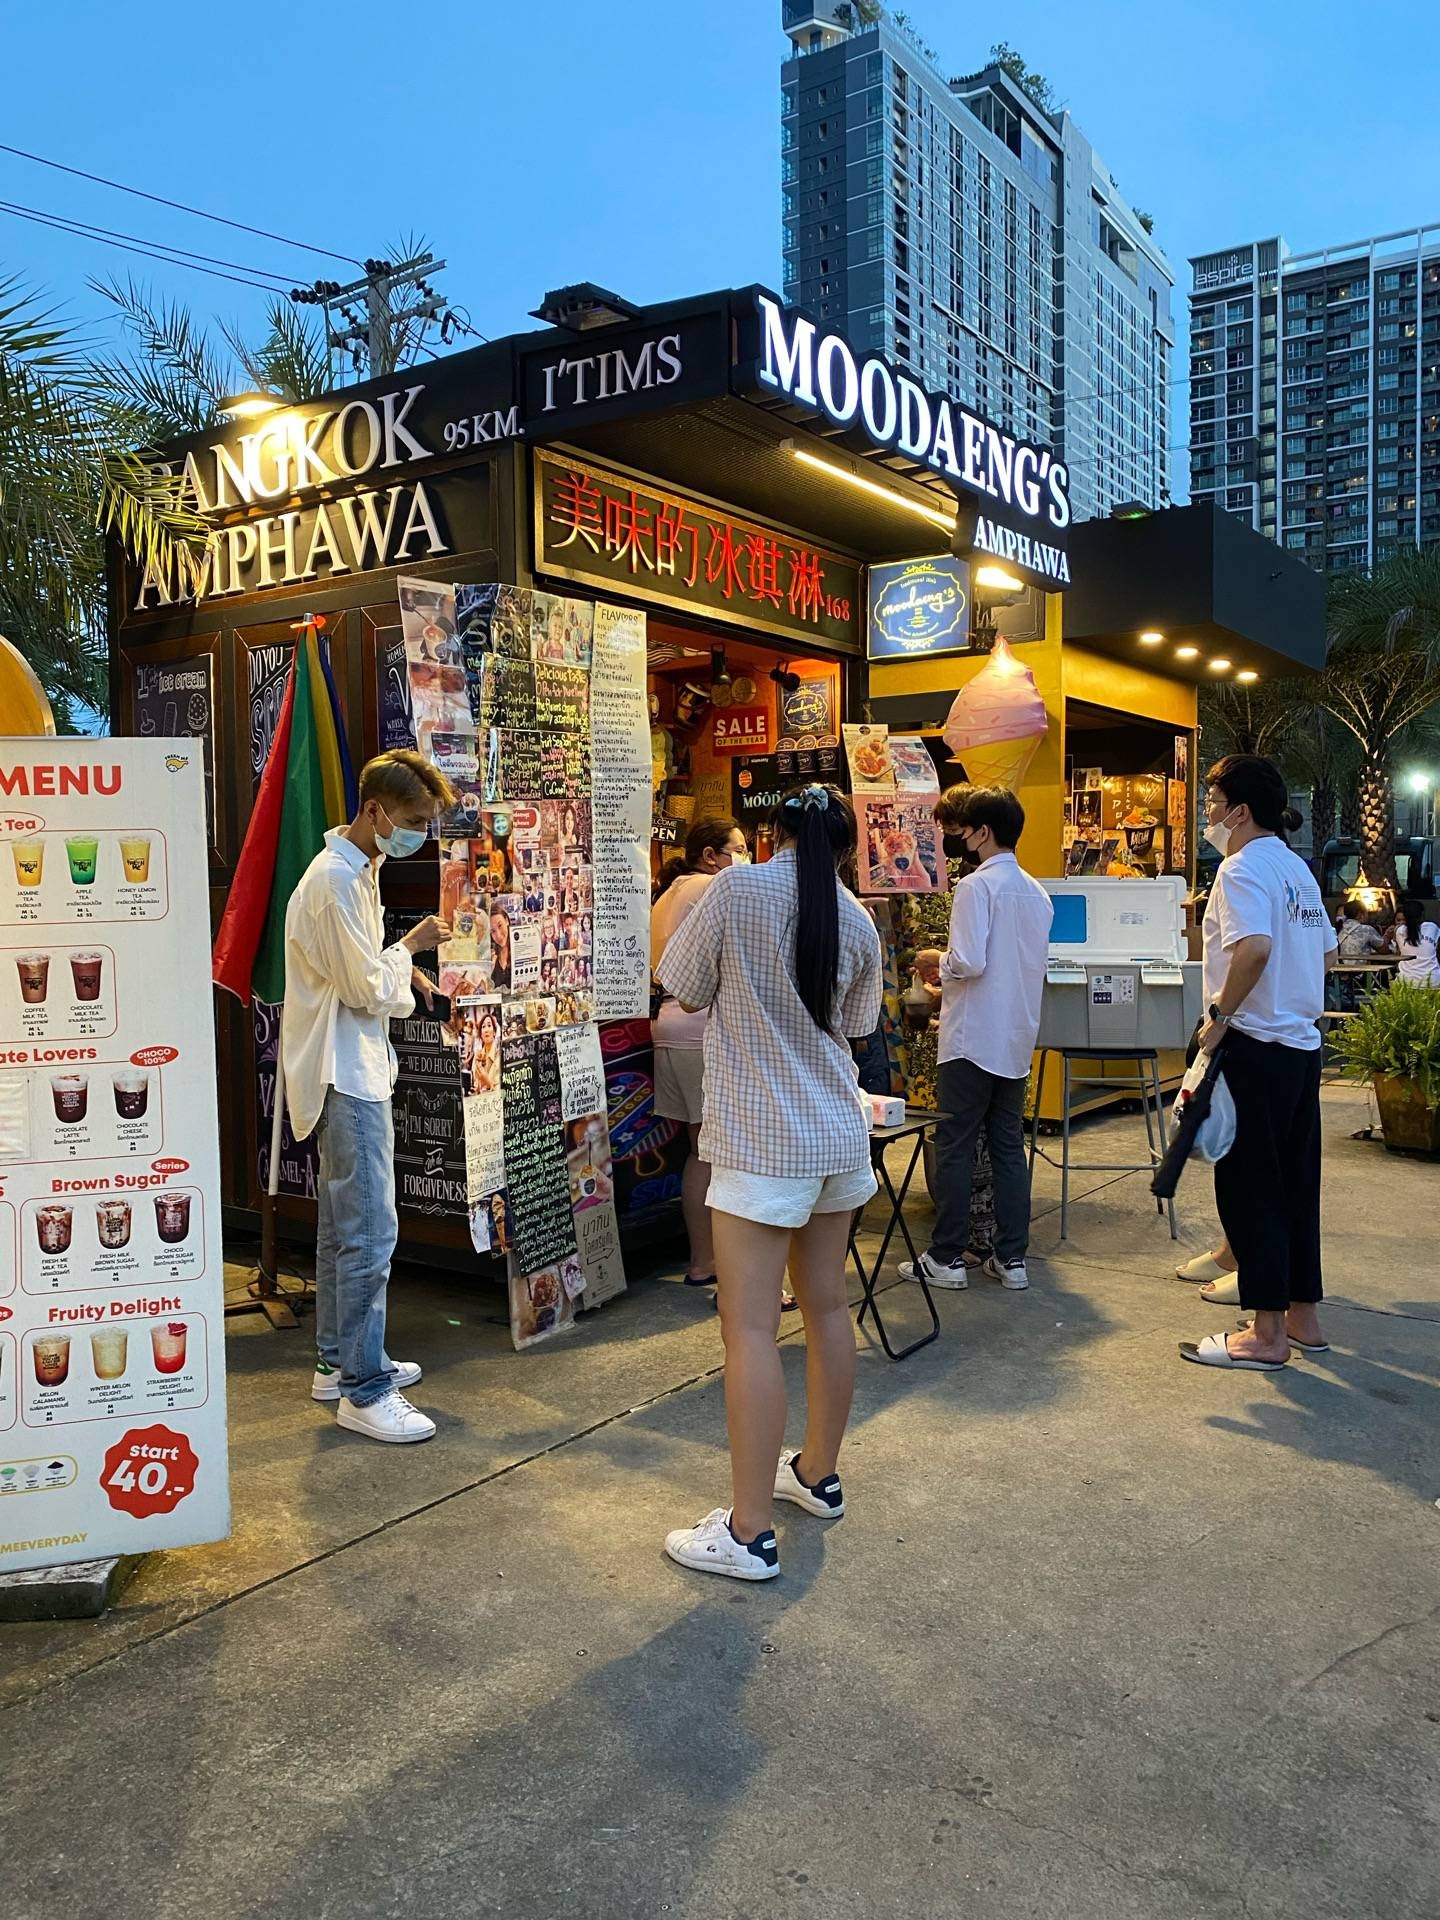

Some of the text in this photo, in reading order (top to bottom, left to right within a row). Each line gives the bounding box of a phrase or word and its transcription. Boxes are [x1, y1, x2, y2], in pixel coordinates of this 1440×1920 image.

[1195, 262, 1253, 286] aspire
[541, 333, 683, 412] I'TIMS
[758, 295, 1071, 528] MOODAENG'S
[134, 481, 449, 611] AMPHAWA
[549, 472, 850, 624] 美味的冰淇淋 168
[973, 515, 1072, 585] AMPHAWA
[715, 715, 766, 735] SALE
[717, 738, 727, 746] OF
[746, 736, 765, 744] YEAR
[0, 765, 122, 796] MENU
[5, 819, 36, 830] Tea
[651, 827, 676, 840] PEN
[404, 1020, 440, 1043] MISTAKES
[33, 1047, 97, 1062] Lovers
[137, 1049, 171, 1059] CHOCO
[143, 1057, 166, 1066] 100%
[407, 1056, 457, 1075] WE DO HUGS
[424, 1117, 453, 1138] SORRY
[155, 1162, 185, 1170] Series
[52, 1173, 169, 1192] Brown Sugar
[404, 1174, 468, 1203] FORGIVENESS
[49, 1296, 181, 1322] Fruity Delight
[129, 1444, 179, 1460] start
[108, 1459, 185, 1496] 40.-
